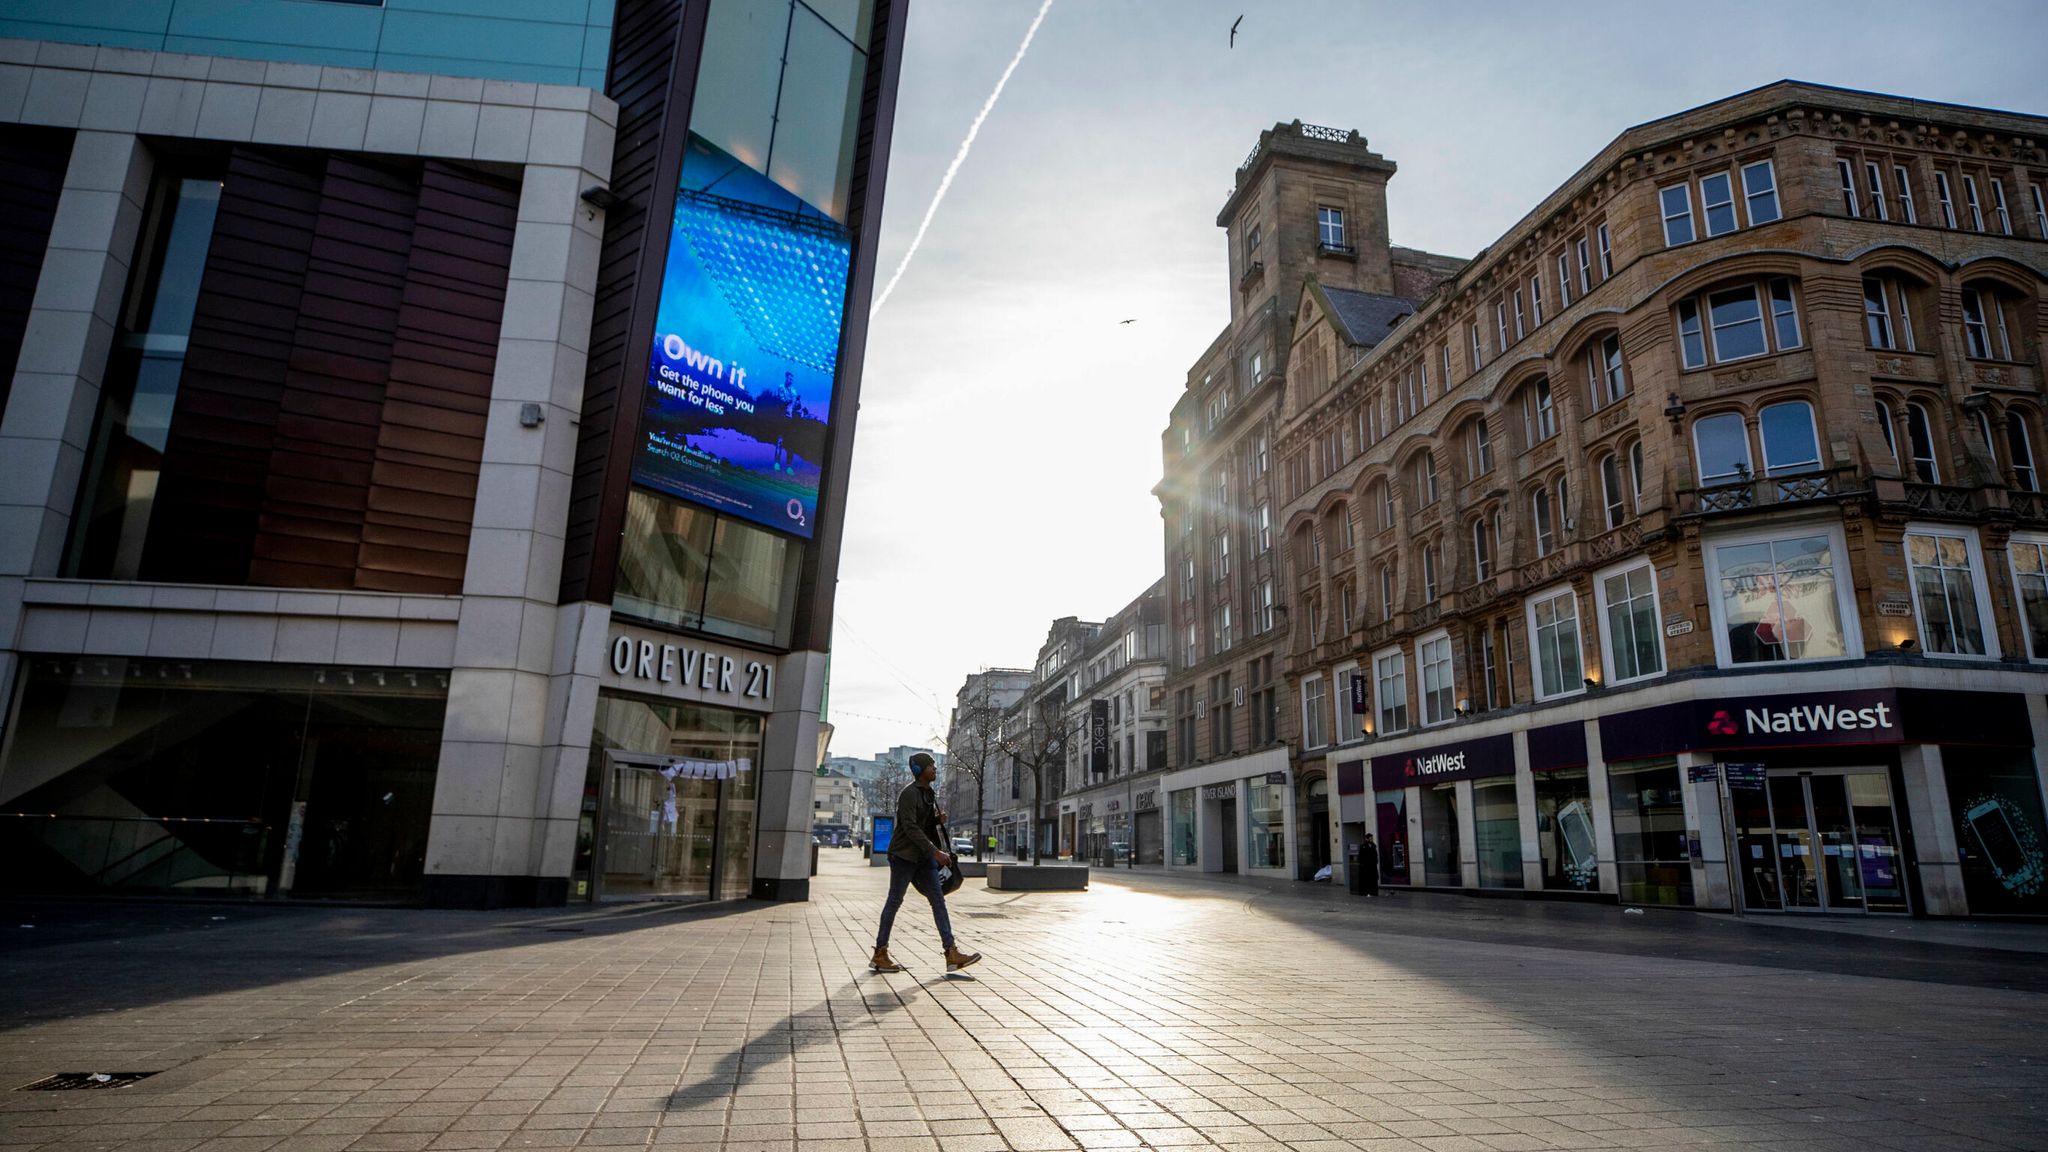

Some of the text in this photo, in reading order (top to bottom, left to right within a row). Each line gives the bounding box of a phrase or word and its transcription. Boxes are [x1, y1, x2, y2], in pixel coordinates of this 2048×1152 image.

[664, 334, 747, 390] Own it
[657, 380, 724, 415] want for less
[660, 364, 755, 414] Get the phone you
[647, 442, 670, 457] Search
[746, 661, 773, 699] 21
[1745, 701, 1893, 734] NatWest
[1094, 717, 1105, 754] next
[1417, 751, 1466, 776] NatWest
[1135, 788, 1155, 809] next
[1217, 784, 1236, 799] ISLAND
